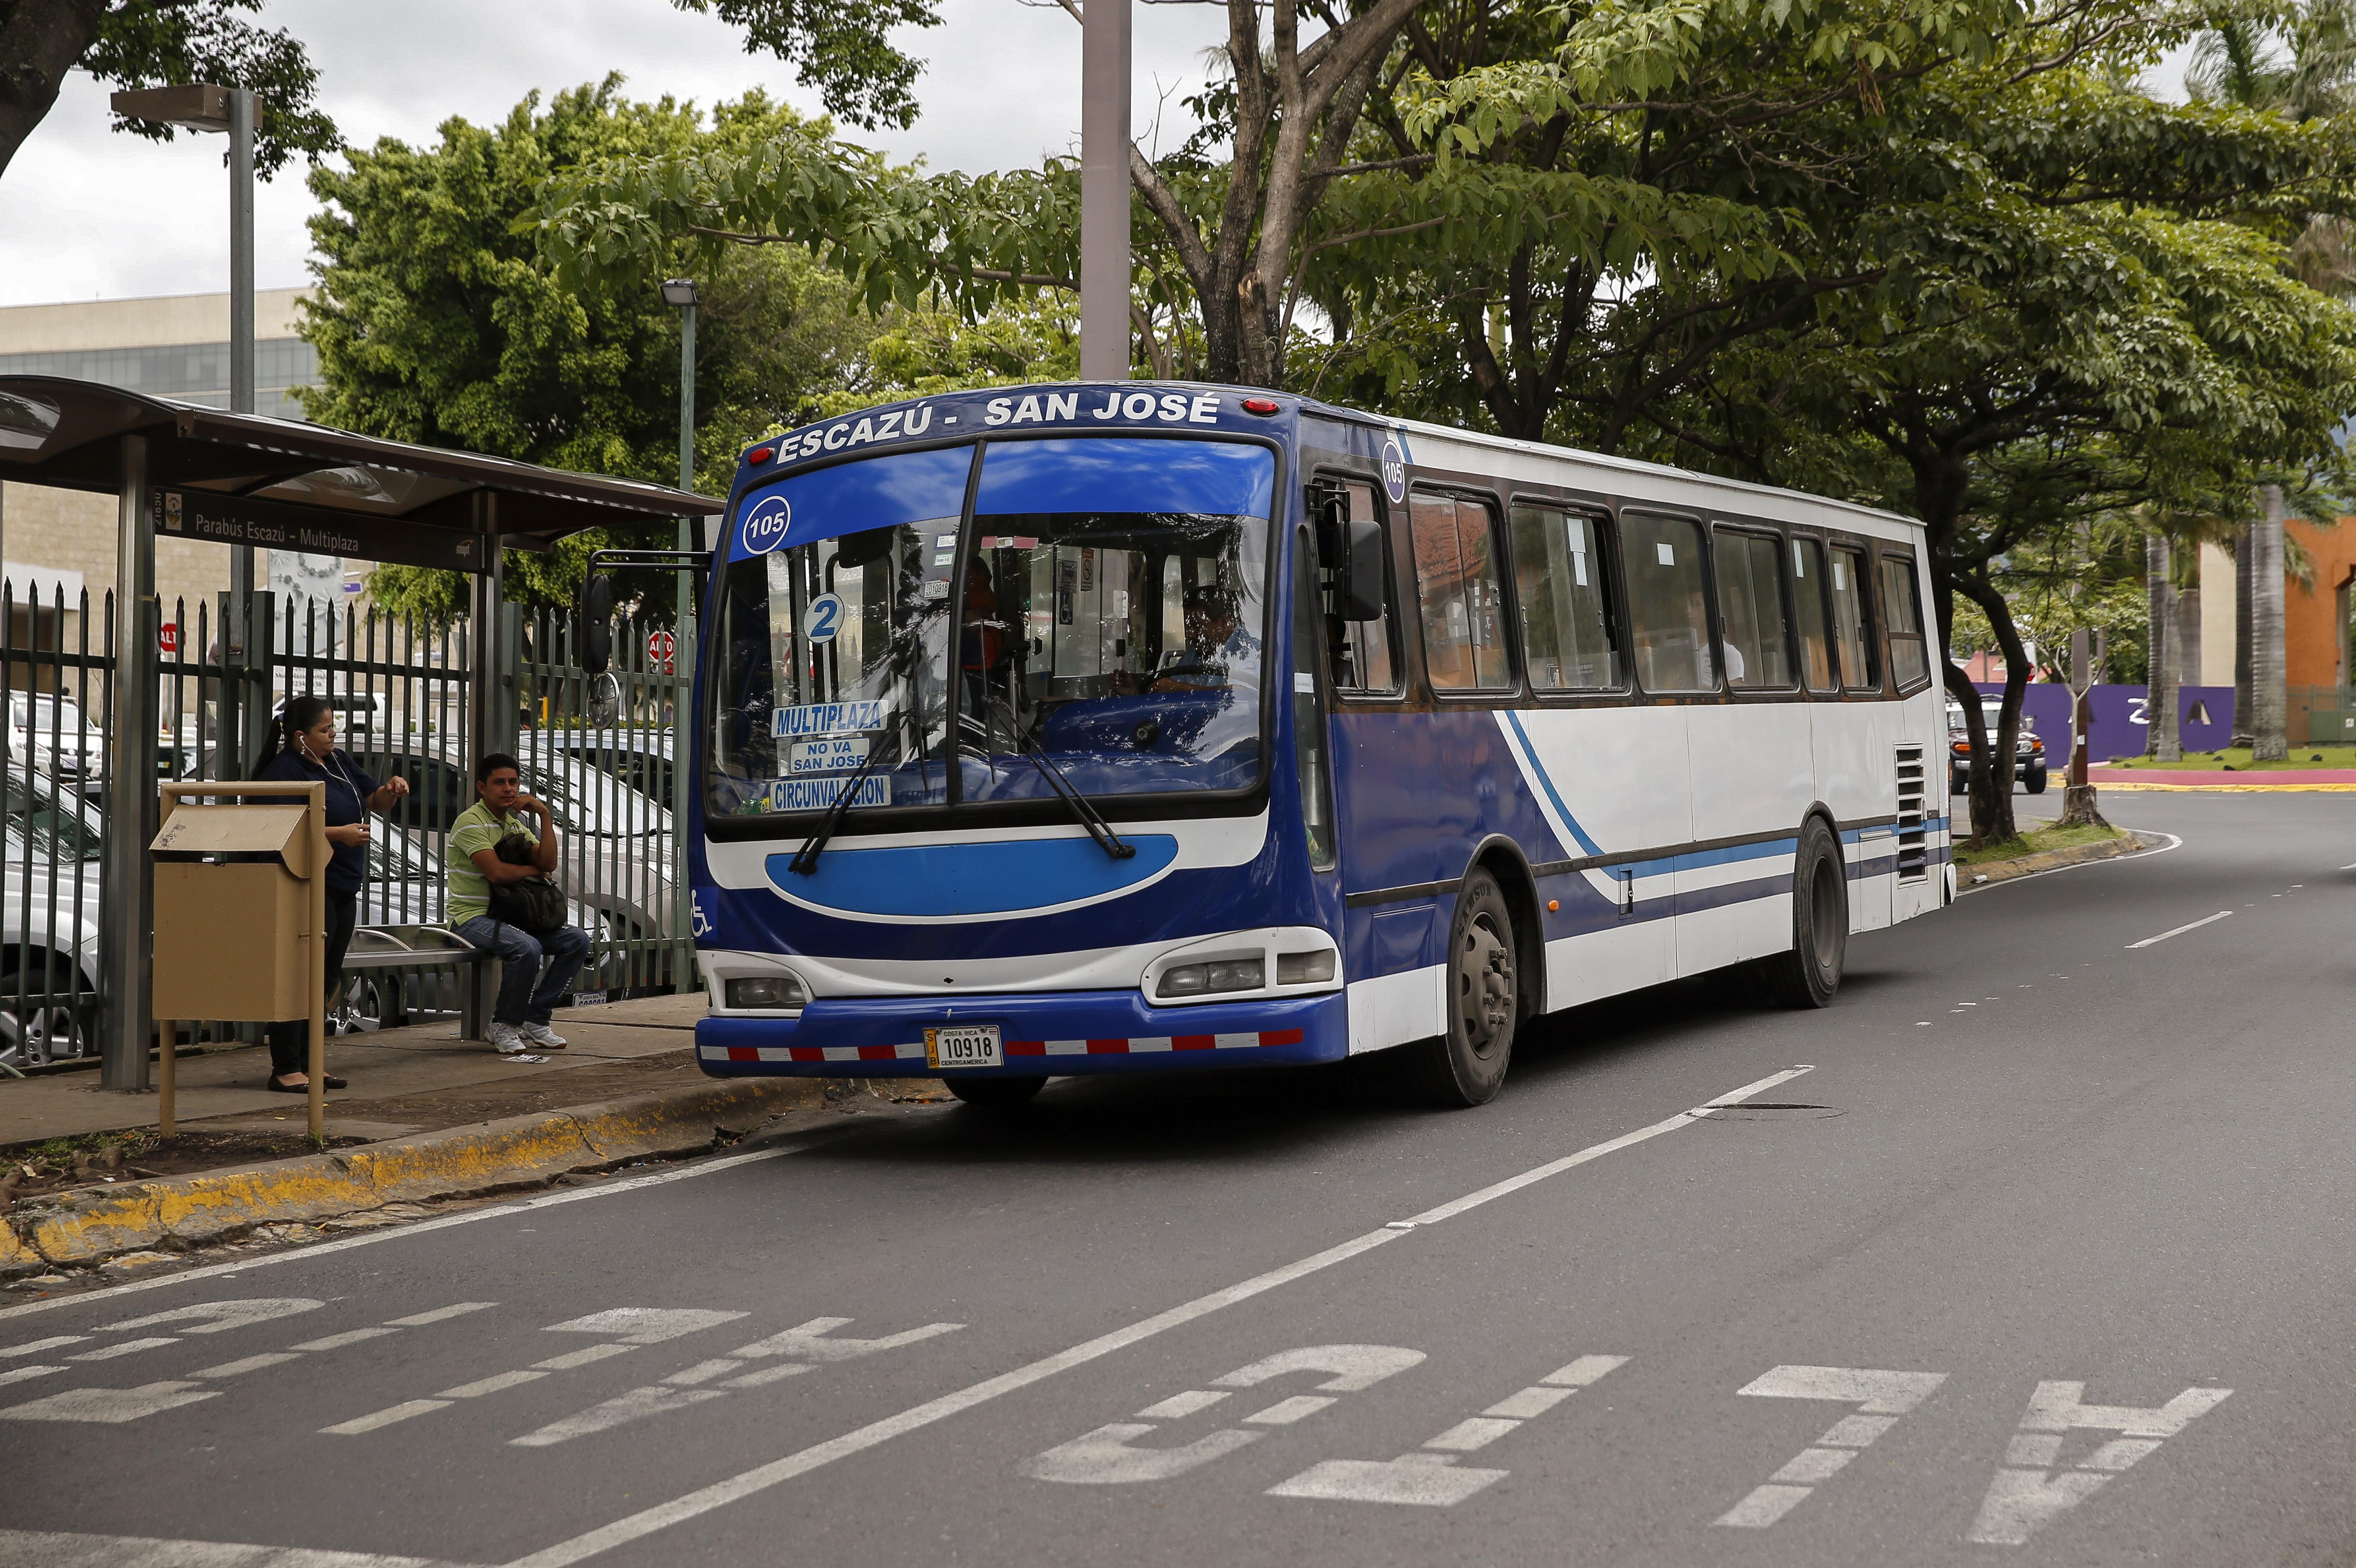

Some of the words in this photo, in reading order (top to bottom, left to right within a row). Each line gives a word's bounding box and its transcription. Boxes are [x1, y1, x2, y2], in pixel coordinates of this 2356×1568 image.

[776, 401, 933, 464] ESCAZÚ
[984, 393, 1079, 426] SAN
[1092, 392, 1221, 424] JOSÉ
[1385, 461, 1402, 484] 105
[196, 514, 242, 537] Parabús
[247, 521, 285, 542] Escazú
[300, 528, 358, 552] Multiplaza
[749, 511, 785, 539] 105
[928, 583, 948, 594] 010918
[810, 599, 837, 637] 2
[161, 630, 176, 644] ALT
[776, 702, 881, 735] MULTIPLAZA
[807, 743, 828, 755] NO
[833, 741, 851, 753] VA
[793, 757, 822, 770] SAN
[826, 754, 865, 768] JOSE
[1458, 881, 1491, 940] SAMSON
[944, 1036, 993, 1058] 10918
